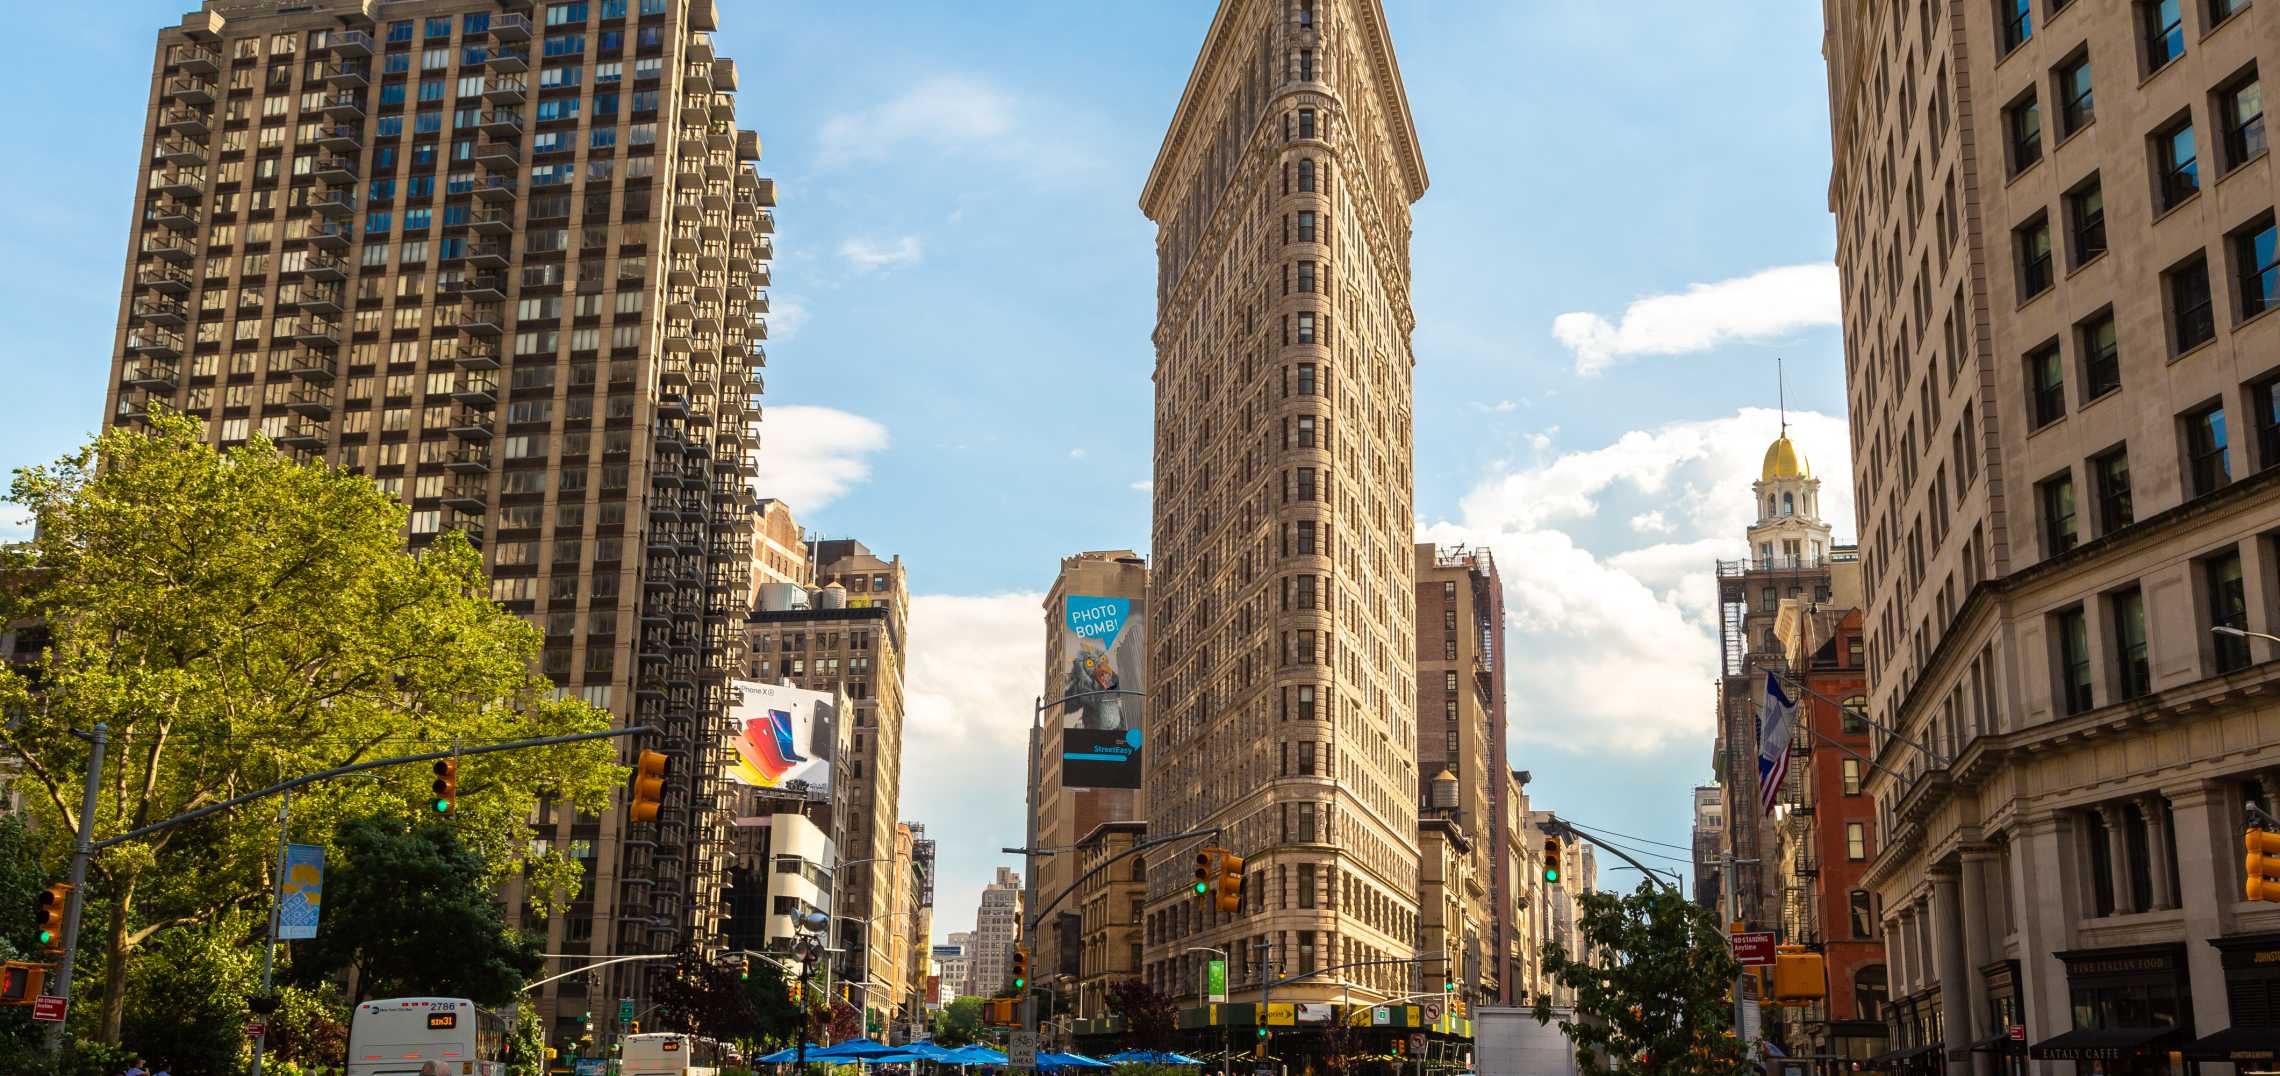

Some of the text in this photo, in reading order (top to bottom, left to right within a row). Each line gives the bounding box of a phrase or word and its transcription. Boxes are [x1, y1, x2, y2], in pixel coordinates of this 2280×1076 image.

[1072, 604, 1116, 624] PHOTO
[1076, 618, 1119, 638] BOMB!
[1094, 744, 1132, 755] StreetEasy
[1733, 935, 1769, 944] NO STANDING
[1734, 944, 1757, 952] Anytime
[2138, 958, 2163, 969] FOOD
[431, 1002, 455, 1011] 2786
[2043, 1048, 2080, 1058] EATALY
